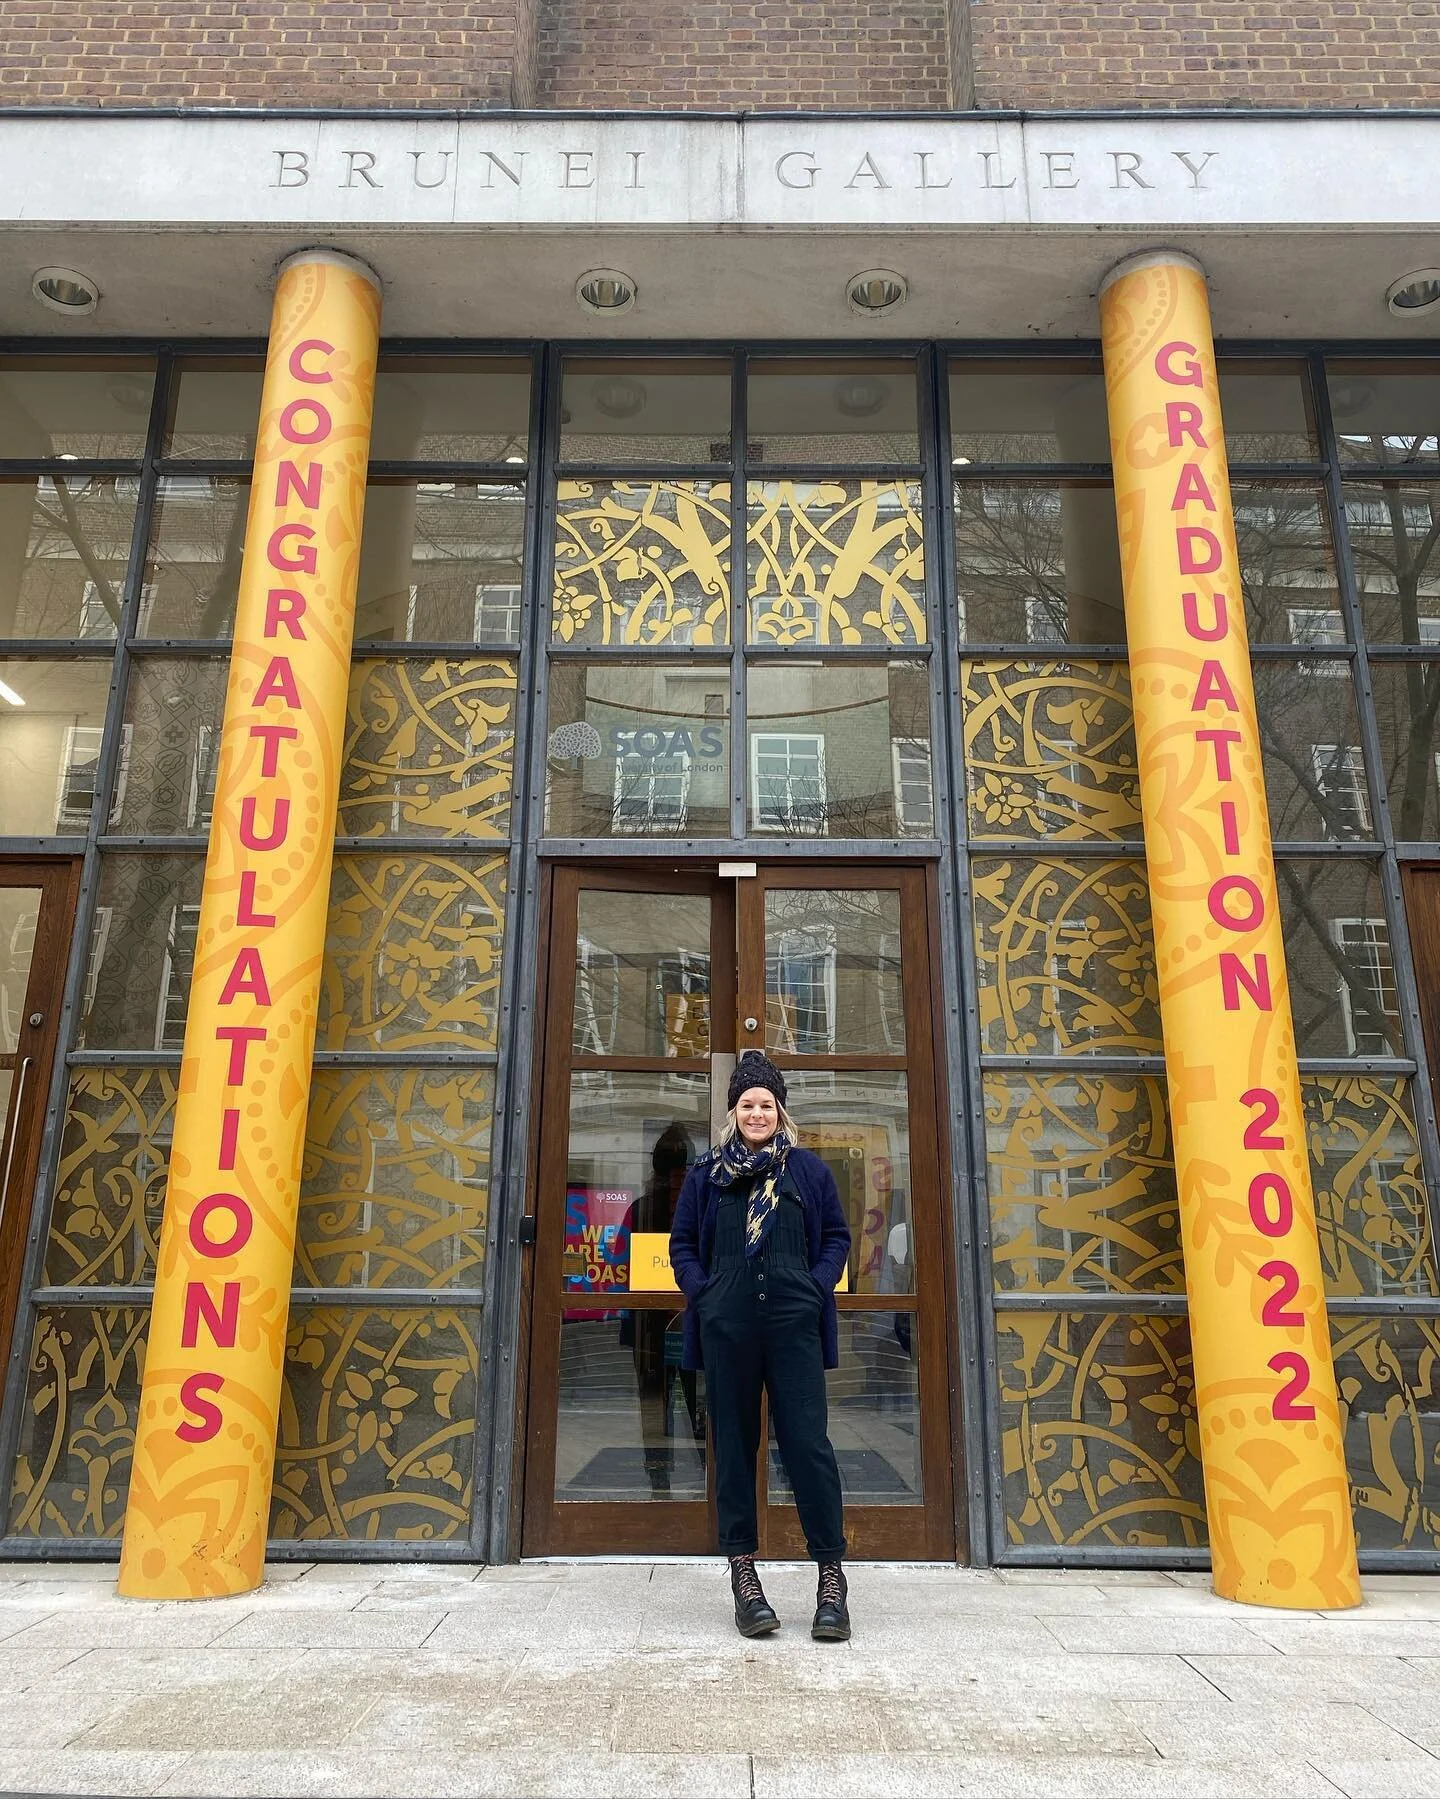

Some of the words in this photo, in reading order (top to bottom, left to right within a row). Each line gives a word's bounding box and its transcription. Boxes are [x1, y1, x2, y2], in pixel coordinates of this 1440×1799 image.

[268, 150, 647, 189] BRUNEI
[774, 150, 1221, 190] GALLERY
[608, 726, 723, 759] SOAS
[681, 763, 723, 773] London
[175, 339, 335, 1443] CONGRATULATIONS
[1154, 341, 1273, 1012] GRADUATION
[1239, 1087, 1317, 1421] 2022
[605, 1192, 628, 1201] SOAS
[581, 1224, 616, 1243] WE
